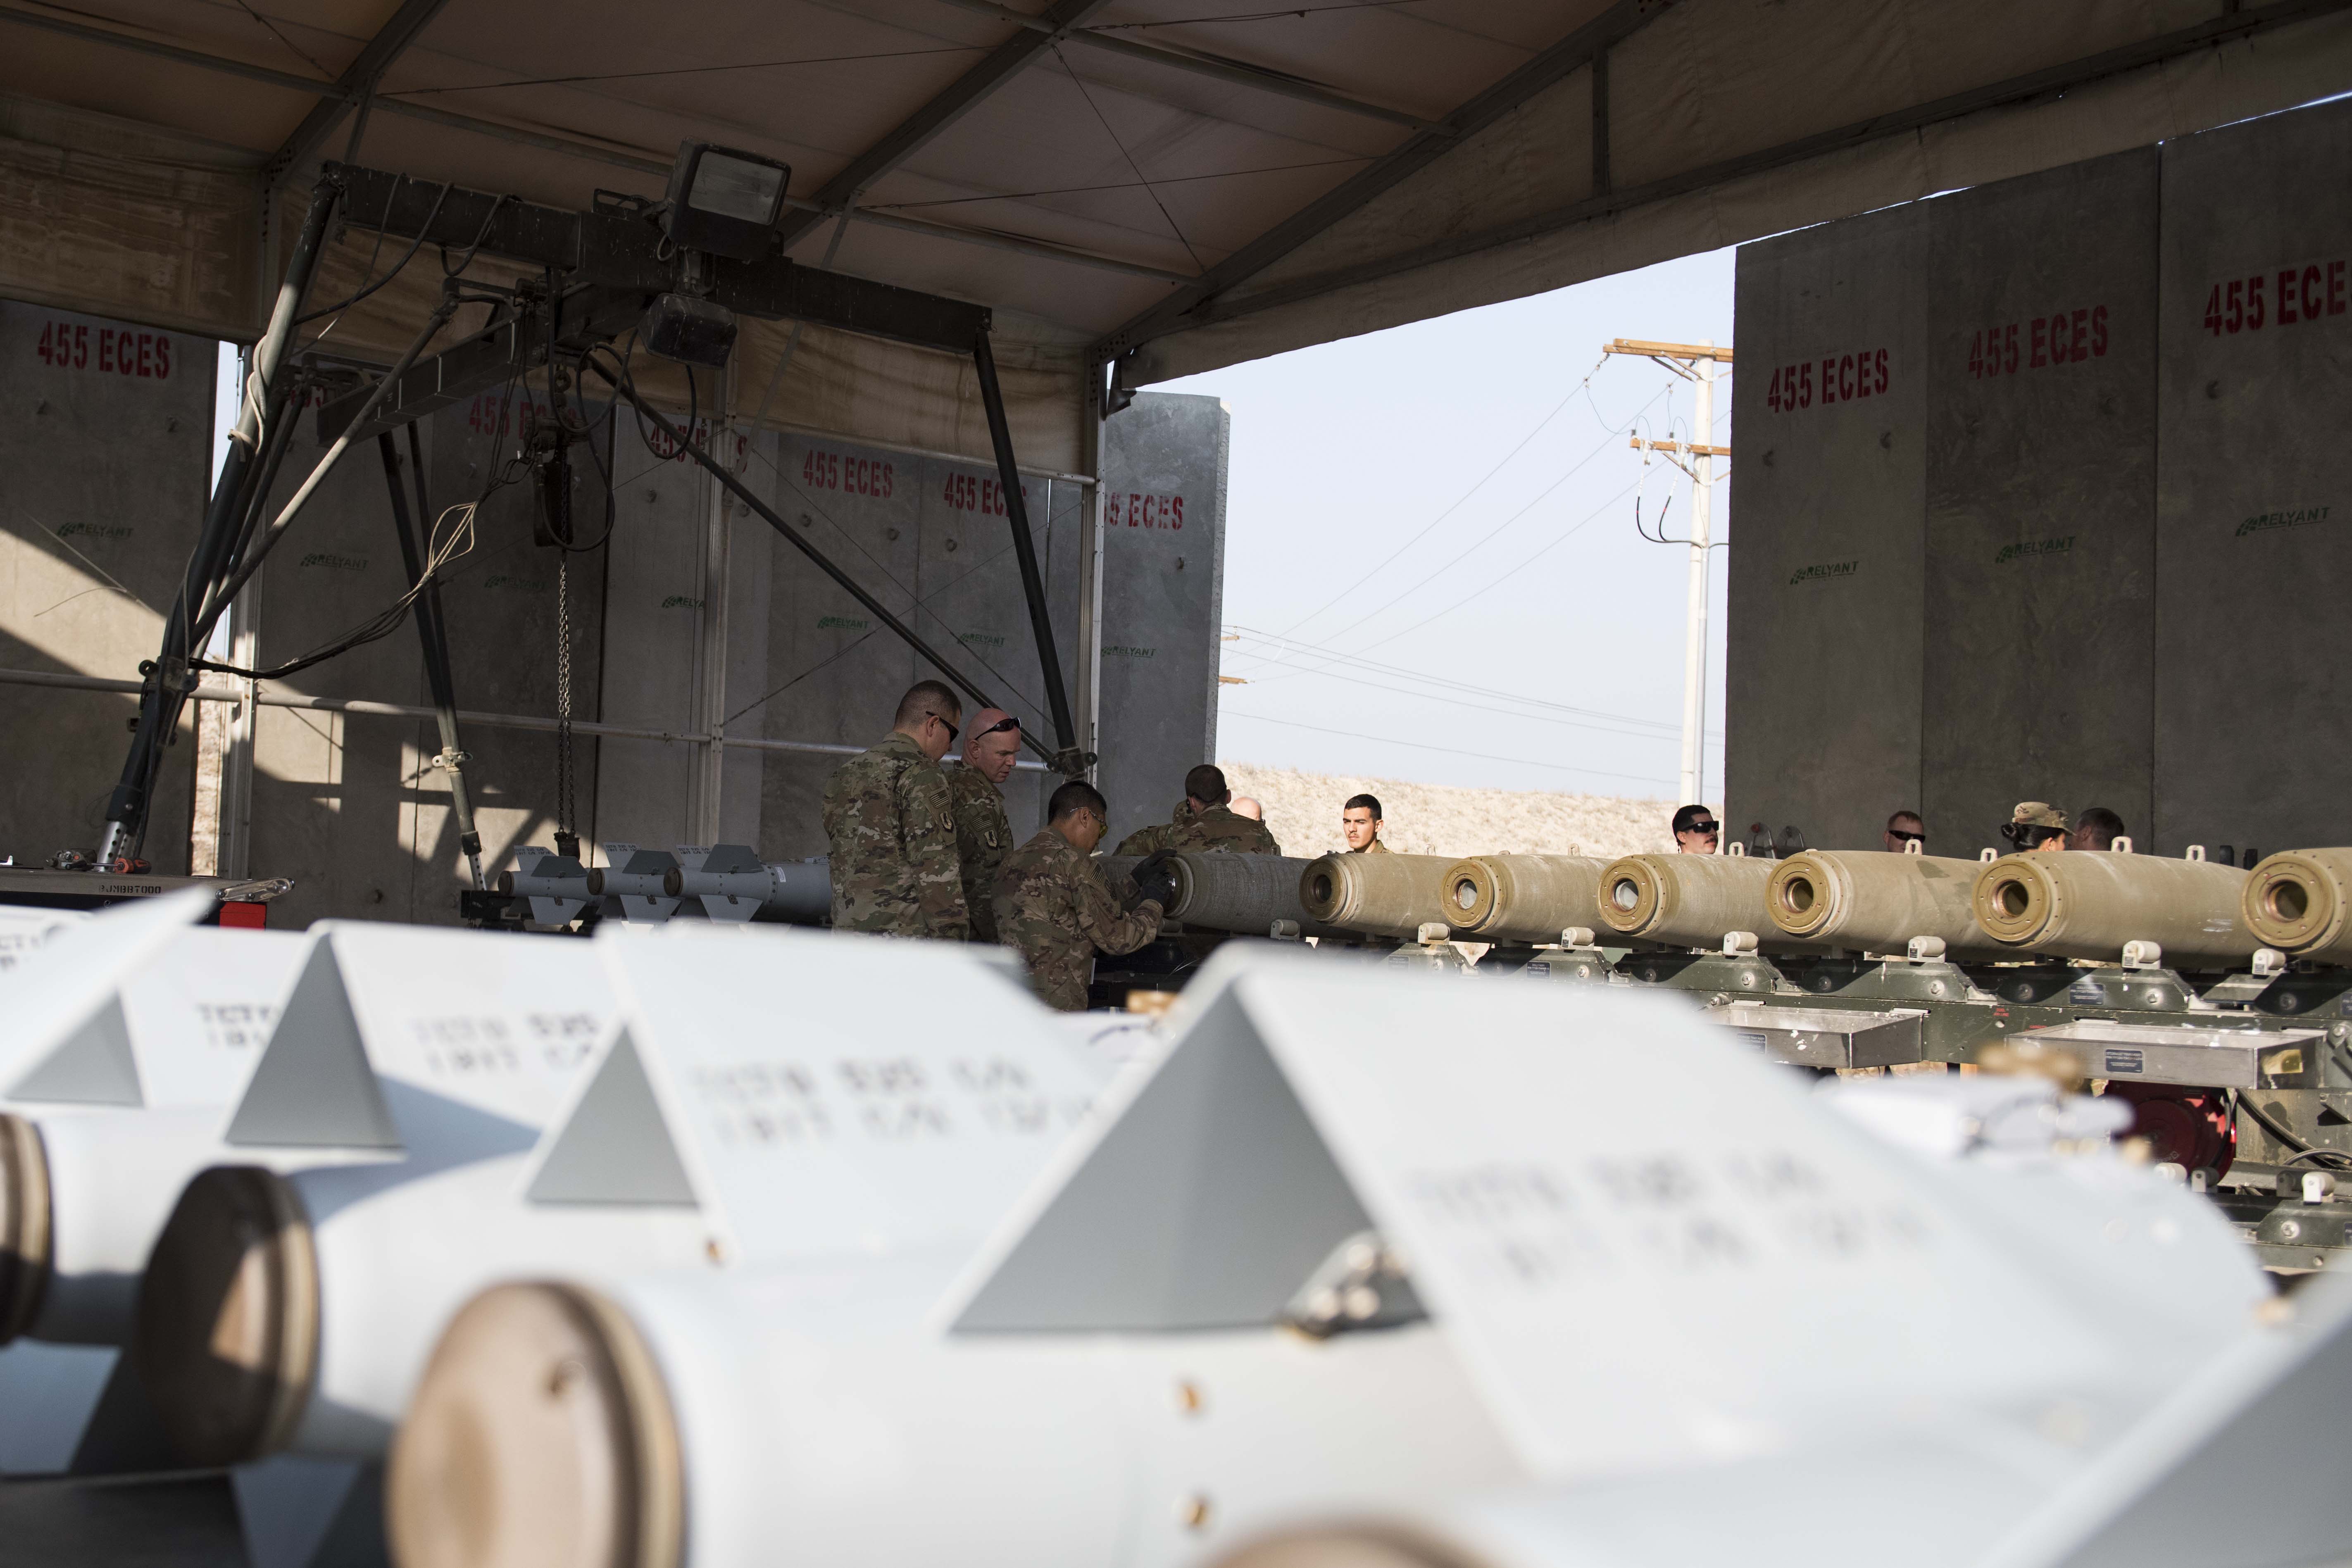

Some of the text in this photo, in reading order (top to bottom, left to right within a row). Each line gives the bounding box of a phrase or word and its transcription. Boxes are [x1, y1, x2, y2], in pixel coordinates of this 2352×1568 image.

[2204, 260, 2352, 337] 455 ECE
[38, 321, 170, 379] 455 ECES
[1969, 305, 2108, 379] 455 ECES
[1767, 347, 1888, 413] 455 ECES
[803, 449, 893, 500] 455 ECES
[944, 472, 976, 512] 455
[1128, 493, 1183, 531] ECES
[2258, 507, 2331, 527] RELYANT
[76, 523, 134, 537] RELYANT
[2015, 536, 2075, 554] RELYANT
[318, 554, 369, 569] RELYANT
[1807, 561, 1859, 577] RELYANT
[500, 576, 547, 590] RELYANT
[676, 596, 705, 609] RELYA
[830, 616, 869, 631] RELYANT
[970, 633, 1005, 645] RELYANT
[1112, 646, 1157, 657] RELYANT
